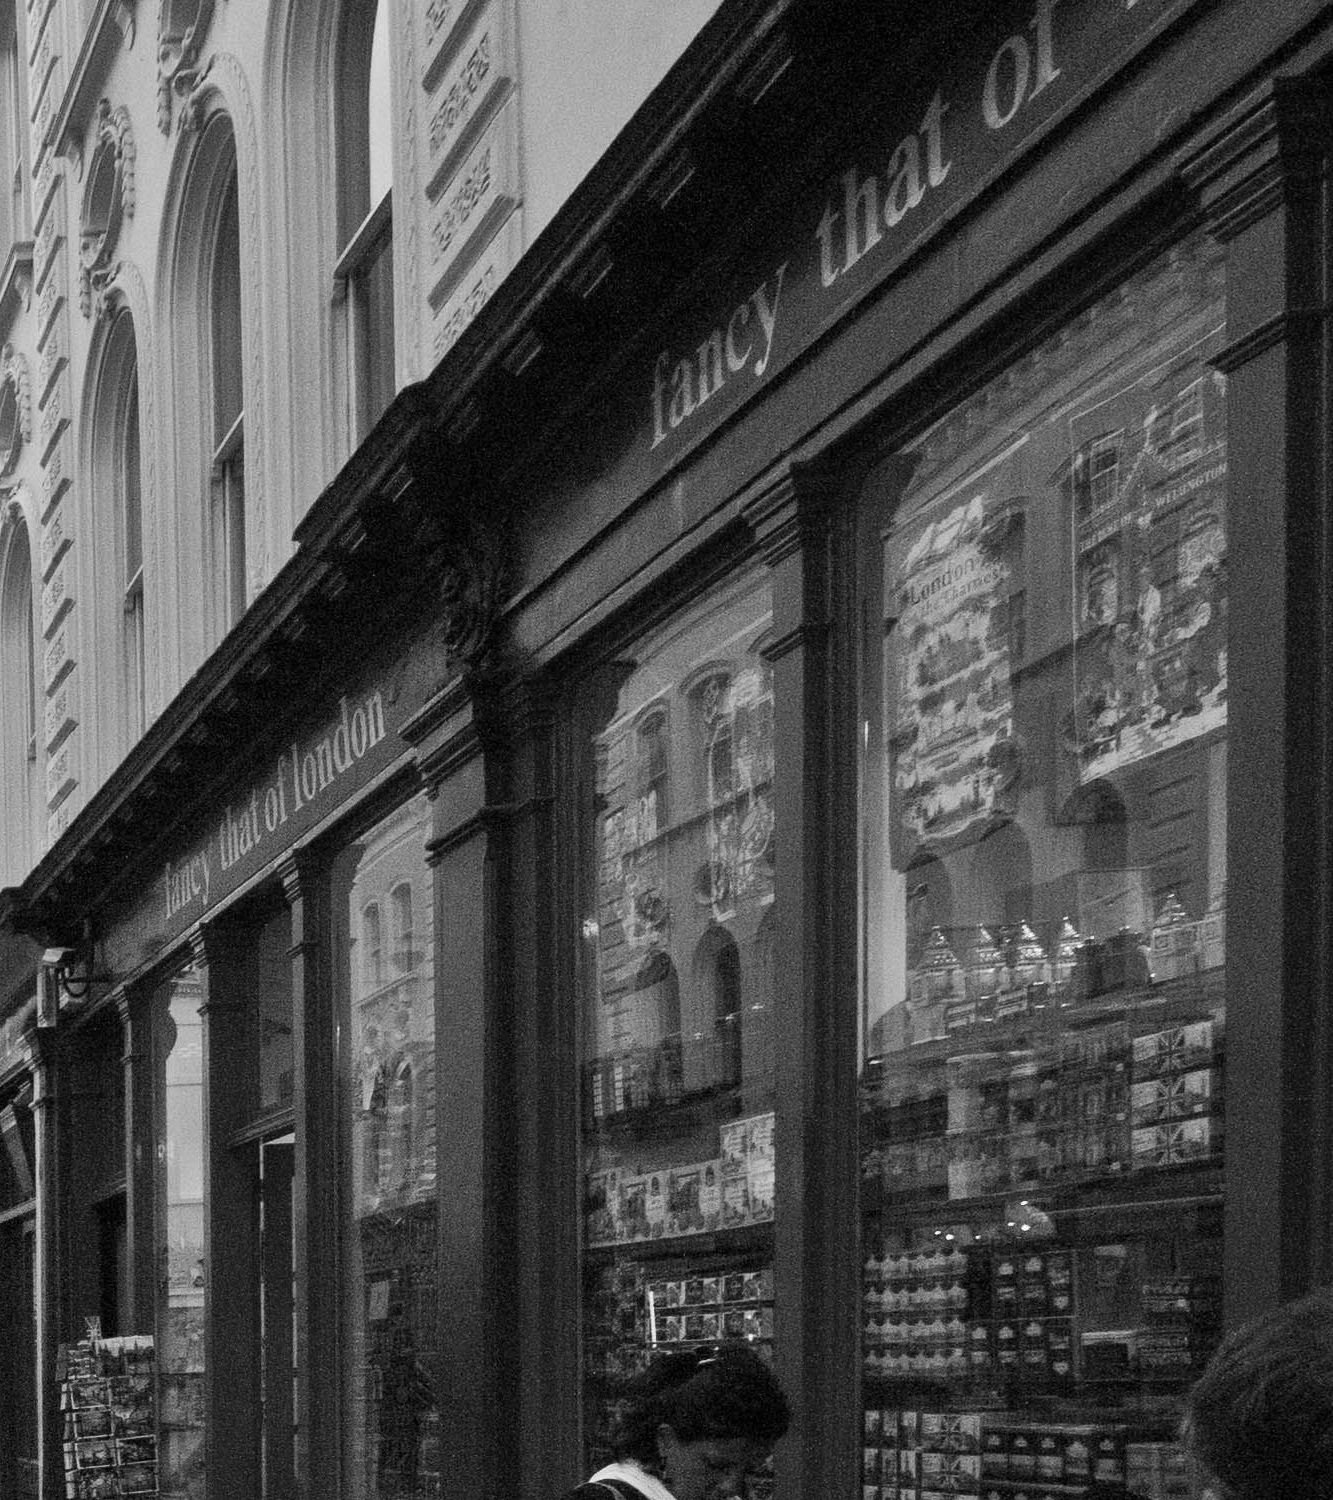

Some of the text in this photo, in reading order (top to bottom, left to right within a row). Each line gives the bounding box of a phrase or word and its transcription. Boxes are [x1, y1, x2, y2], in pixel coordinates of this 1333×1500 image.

[647, 261, 788, 451] fancy
[816, 88, 954, 288] that
[909, 557, 975, 606] London
[164, 690, 386, 919] fancy that of london
